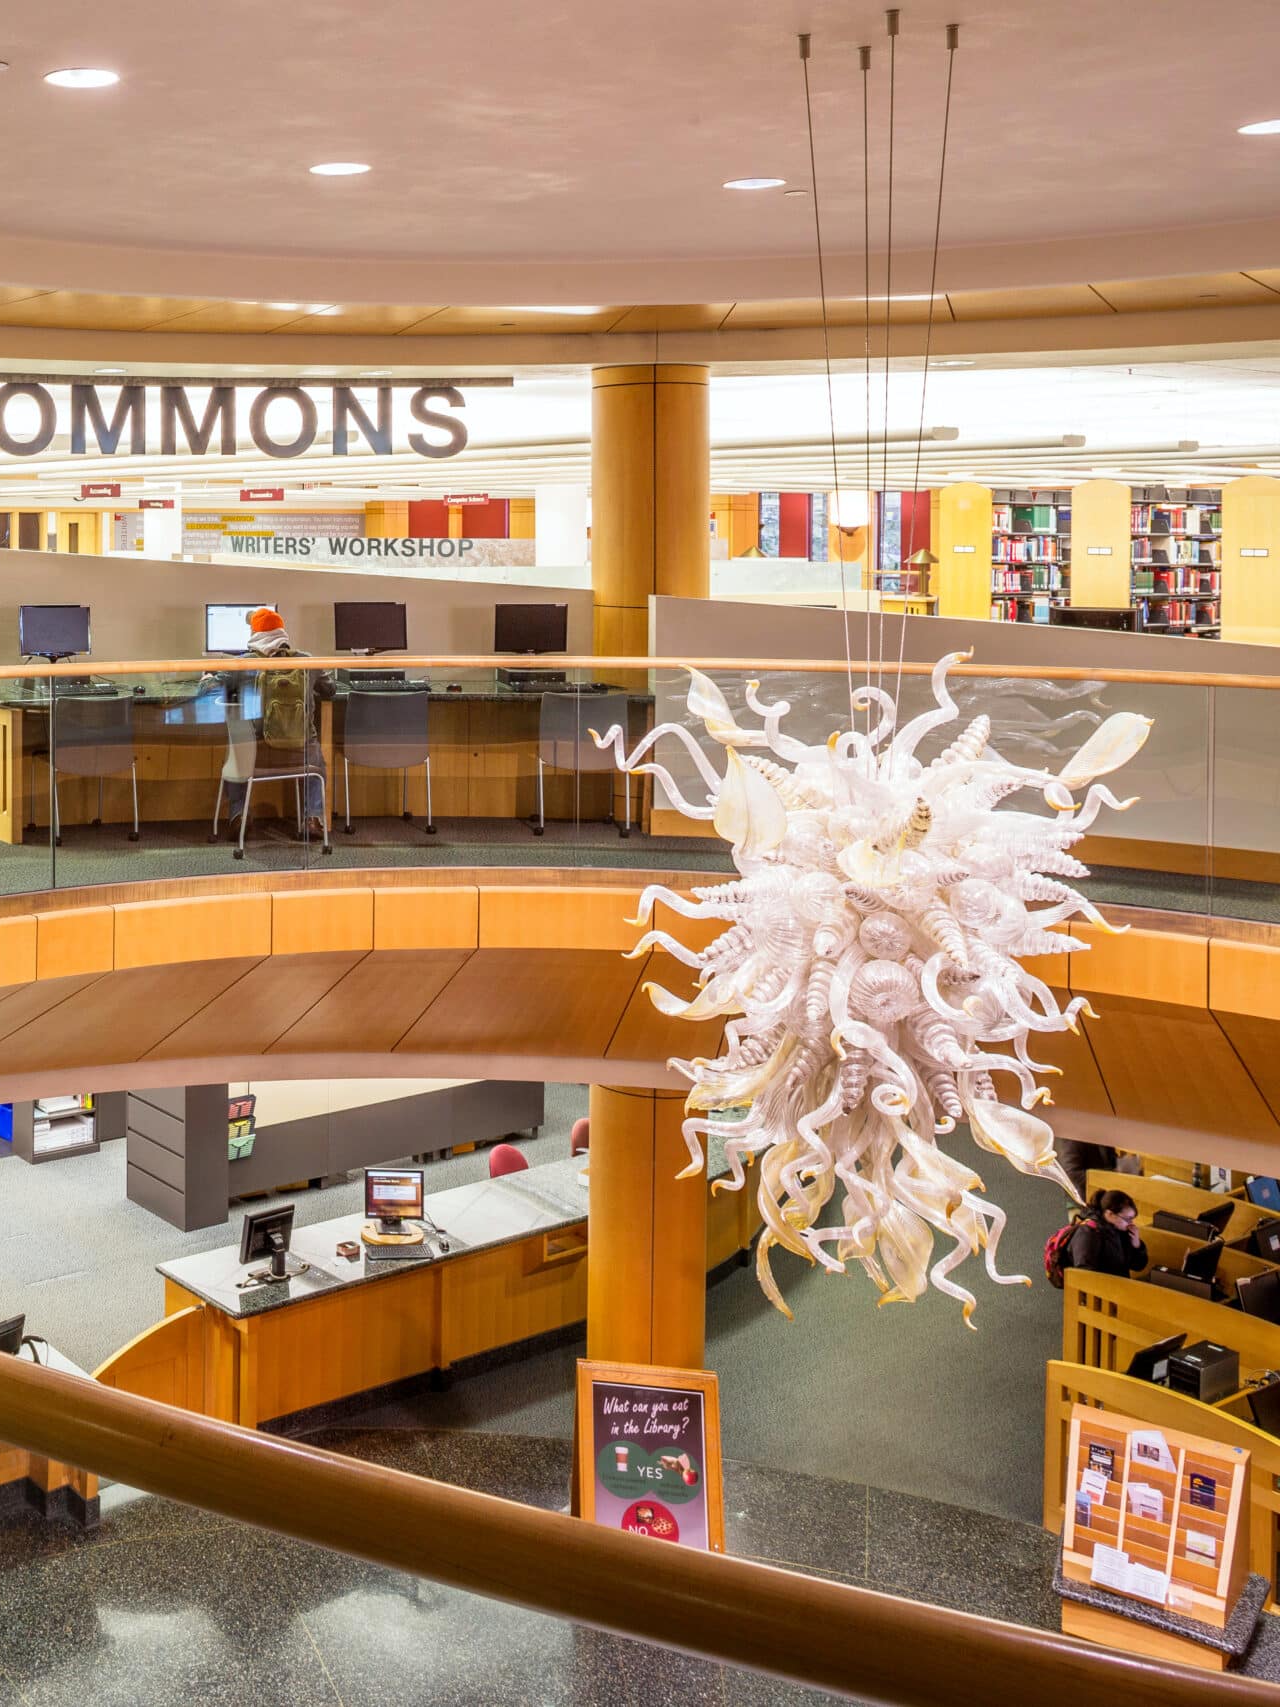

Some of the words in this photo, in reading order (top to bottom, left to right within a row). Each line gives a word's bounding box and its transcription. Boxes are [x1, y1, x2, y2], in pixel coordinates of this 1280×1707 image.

[231, 536, 316, 556] WRITERS'
[328, 537, 474, 558] WORKSHOP
[604, 1396, 629, 1415] What
[632, 1403, 648, 1414] can
[652, 1403, 669, 1418] you
[672, 1398, 689, 1412] eat
[611, 1420, 619, 1435] in
[623, 1419, 639, 1434] the
[644, 1416, 690, 1440] Library?
[637, 1465, 664, 1480] YES
[628, 1524, 649, 1536] NO
